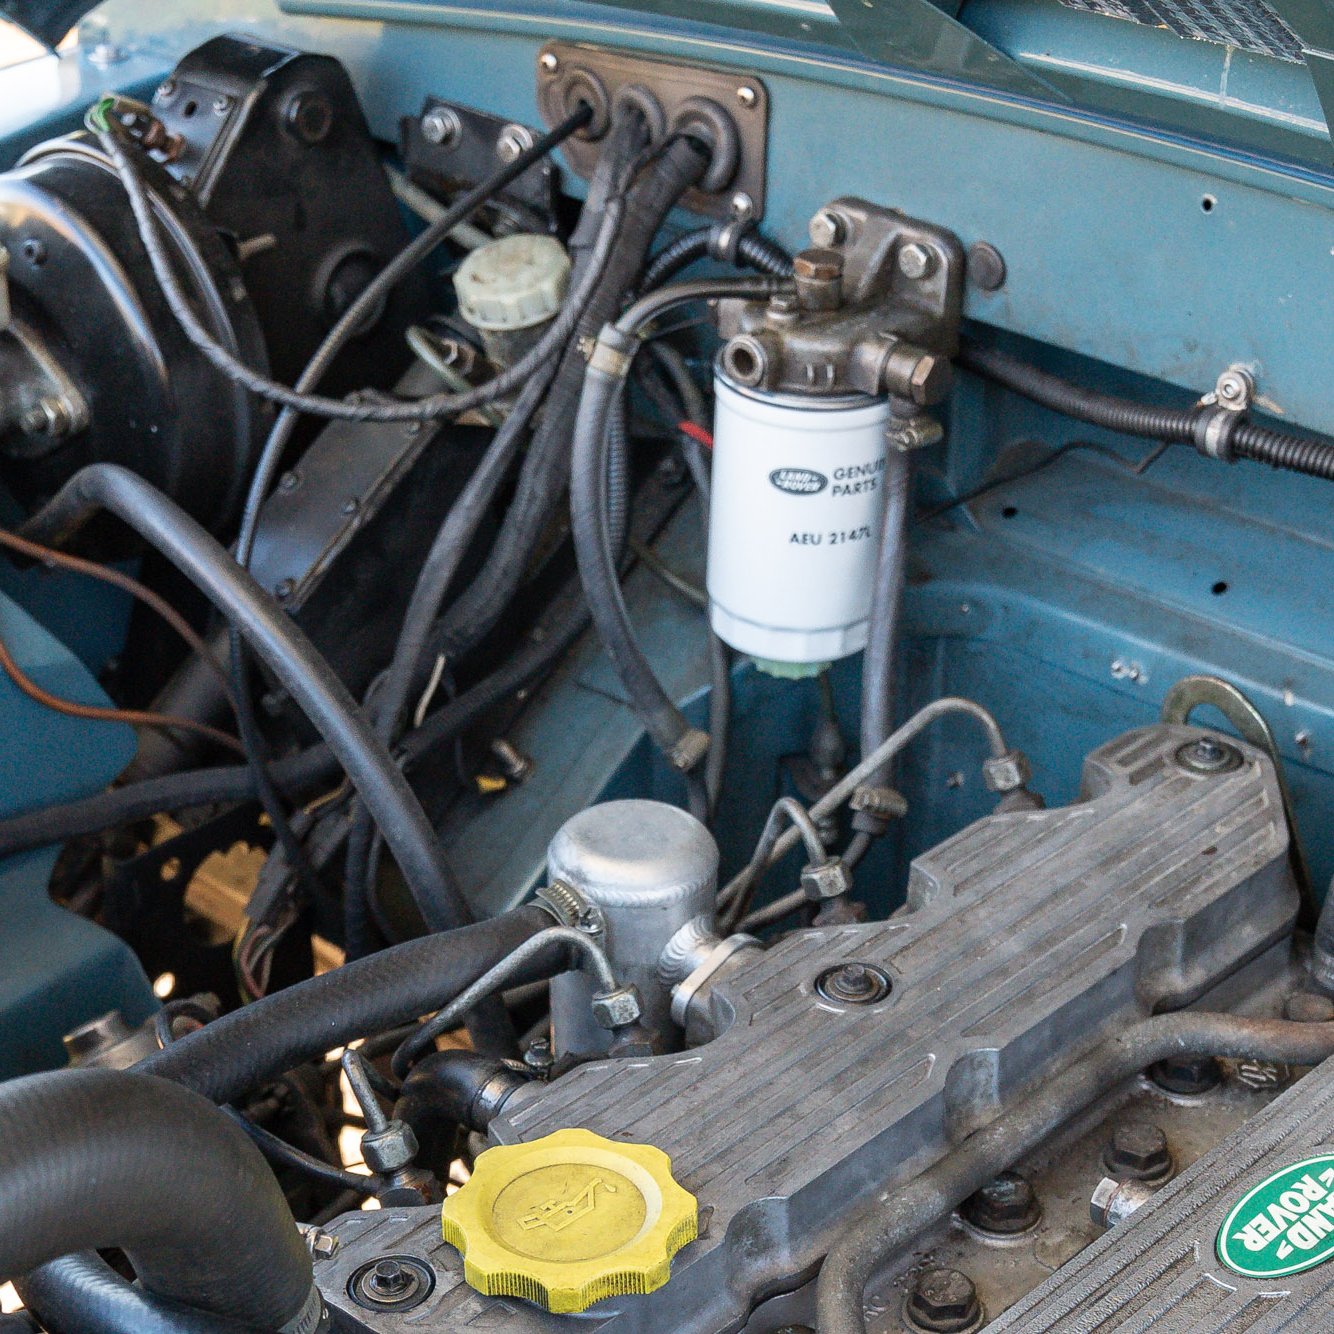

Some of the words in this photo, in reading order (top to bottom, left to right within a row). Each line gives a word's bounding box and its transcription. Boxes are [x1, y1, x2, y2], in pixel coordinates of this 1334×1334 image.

[831, 478, 878, 497] PARTS
[788, 533, 823, 546] AEU
[1231, 1173, 1329, 1252] ROVER
